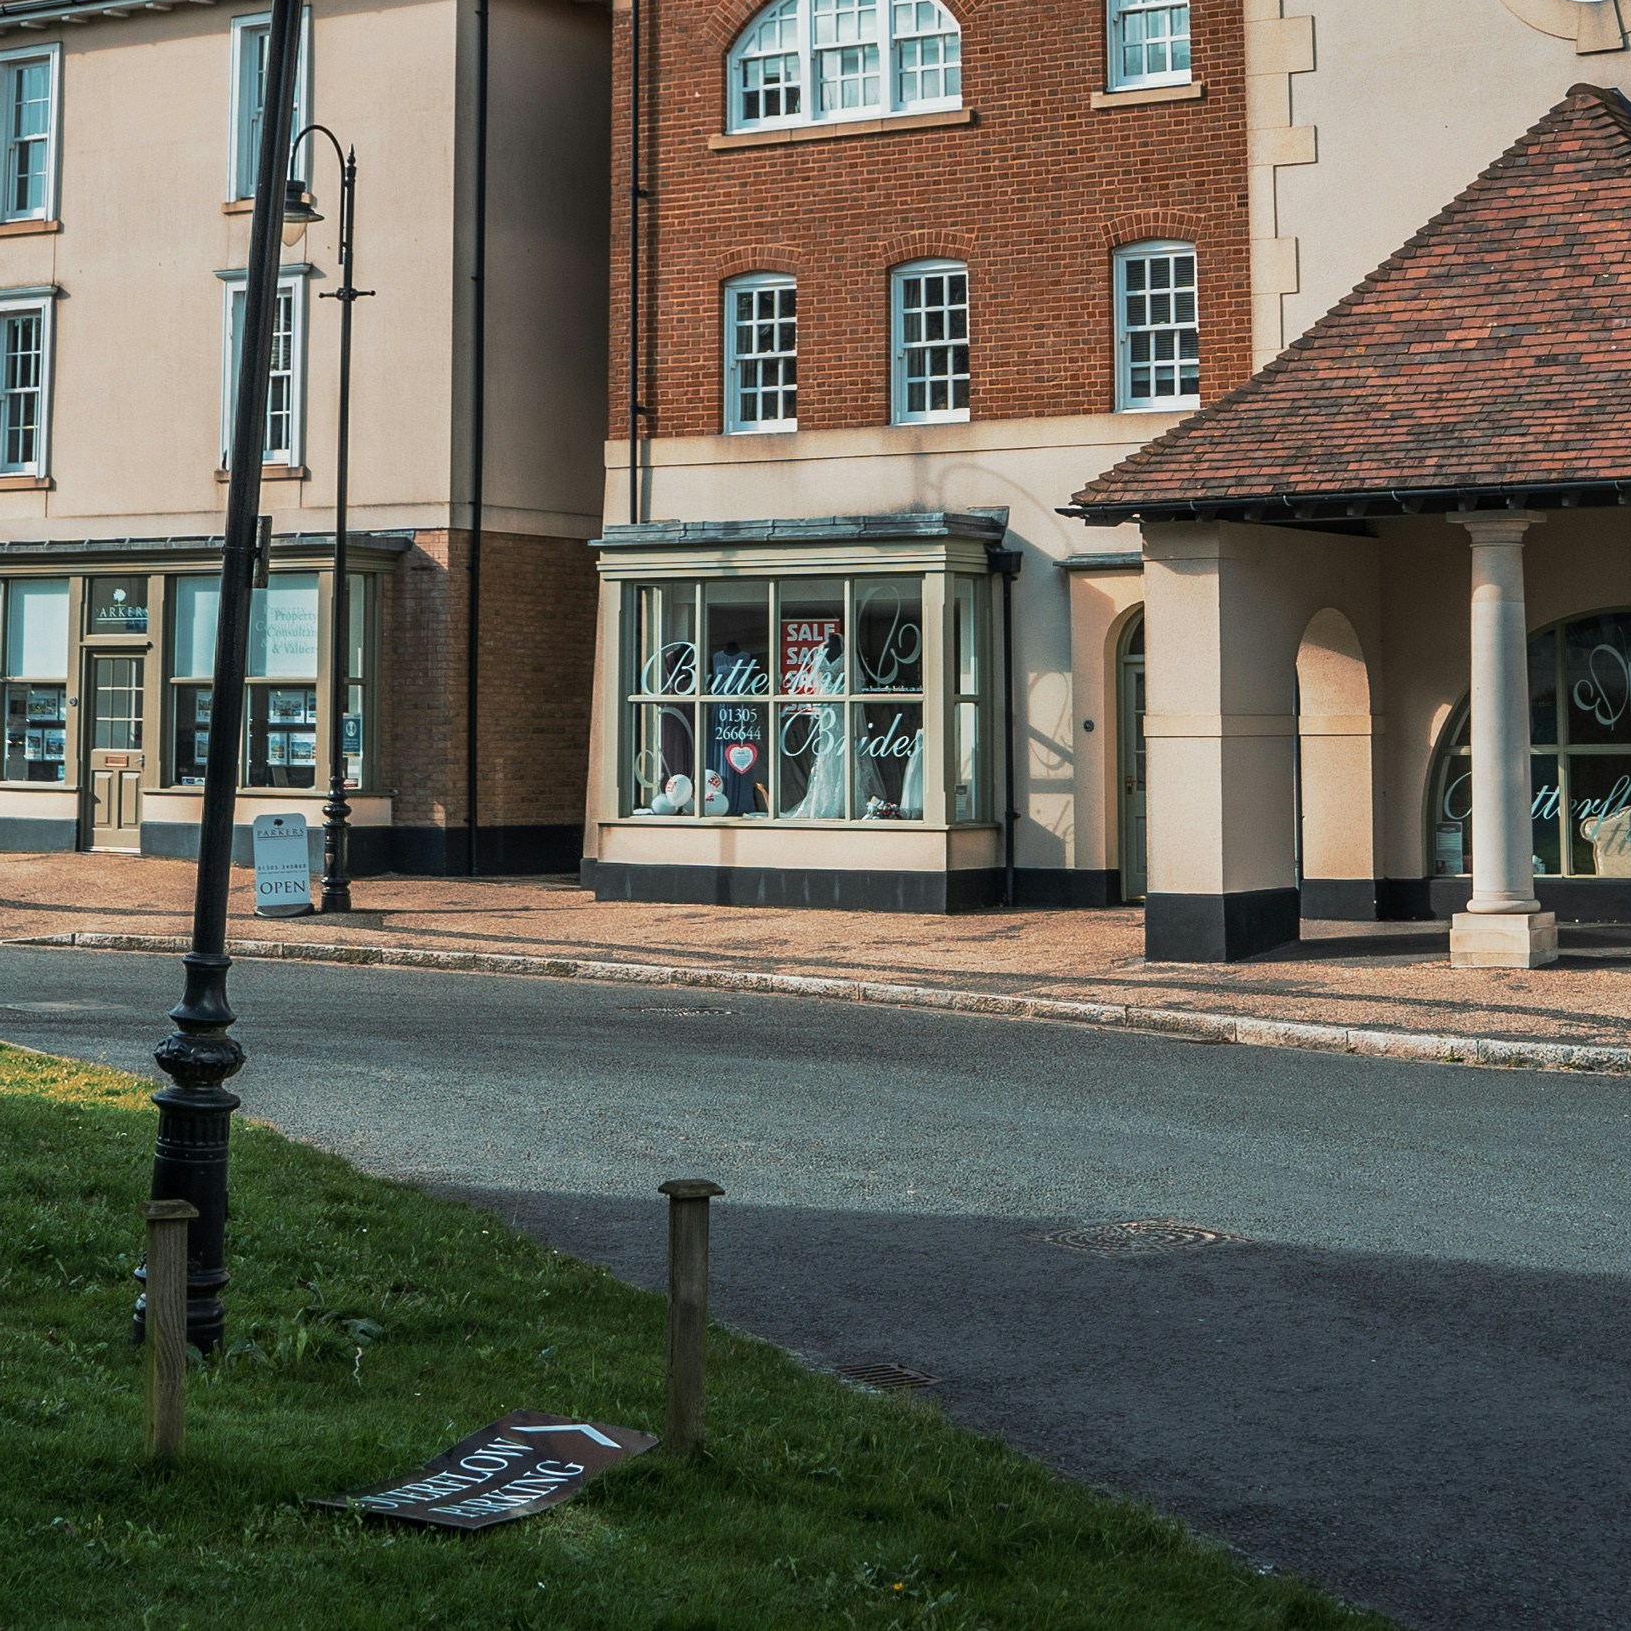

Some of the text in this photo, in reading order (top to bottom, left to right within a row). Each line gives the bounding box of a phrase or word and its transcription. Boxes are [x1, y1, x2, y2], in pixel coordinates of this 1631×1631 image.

[786, 623, 836, 642] SALE
[641, 641, 846, 695] Buttefly
[719, 708, 758, 723] 01305
[715, 725, 762, 741] 266644
[257, 828, 305, 837] PARKERS
[259, 880, 306, 895] OPEN
[354, 1436, 534, 1510] OVERFLOW
[427, 1459, 585, 1518] PARKING
